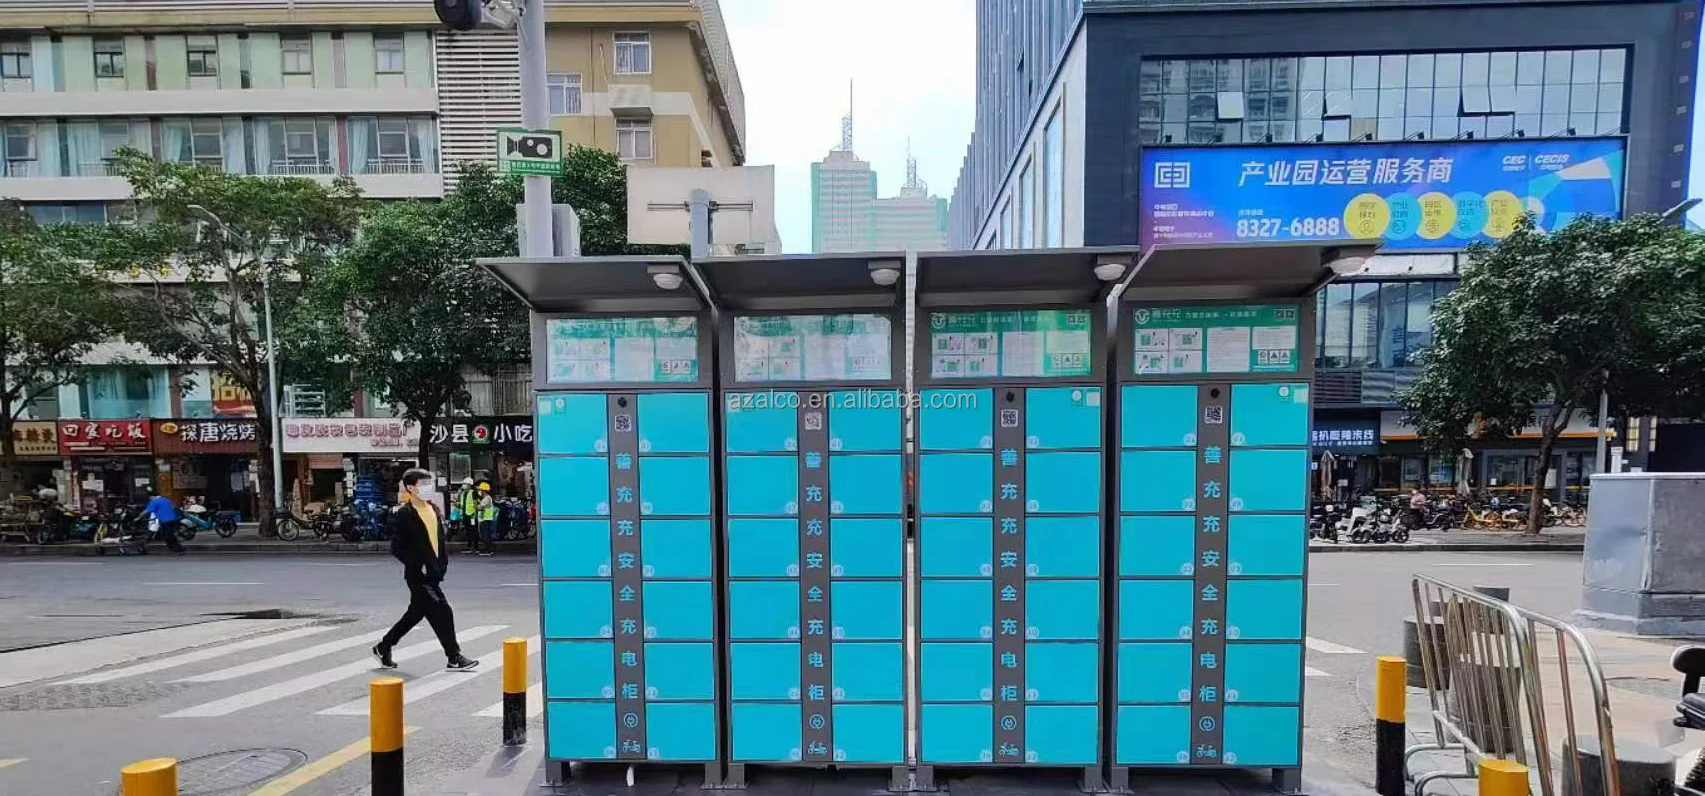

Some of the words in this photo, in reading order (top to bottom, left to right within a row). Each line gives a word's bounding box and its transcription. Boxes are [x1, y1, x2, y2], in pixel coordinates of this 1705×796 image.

[1238, 157, 1454, 187] 产业园运营服务商
[1502, 155, 1526, 164] CEC
[1236, 217, 1340, 237] 8327-6888
[63, 422, 146, 439] 回家吃饭
[181, 422, 256, 442] 探唐烧烤
[429, 423, 469, 443] 沙县
[493, 423, 532, 443] 小吃
[615, 453, 638, 699] 善充充安全充电柜
[804, 452, 824, 701] 善充充安全充电柜
[1000, 448, 1018, 701] 善充充安全充电柜
[1199, 446, 1223, 702] 善充充安全充电柜
